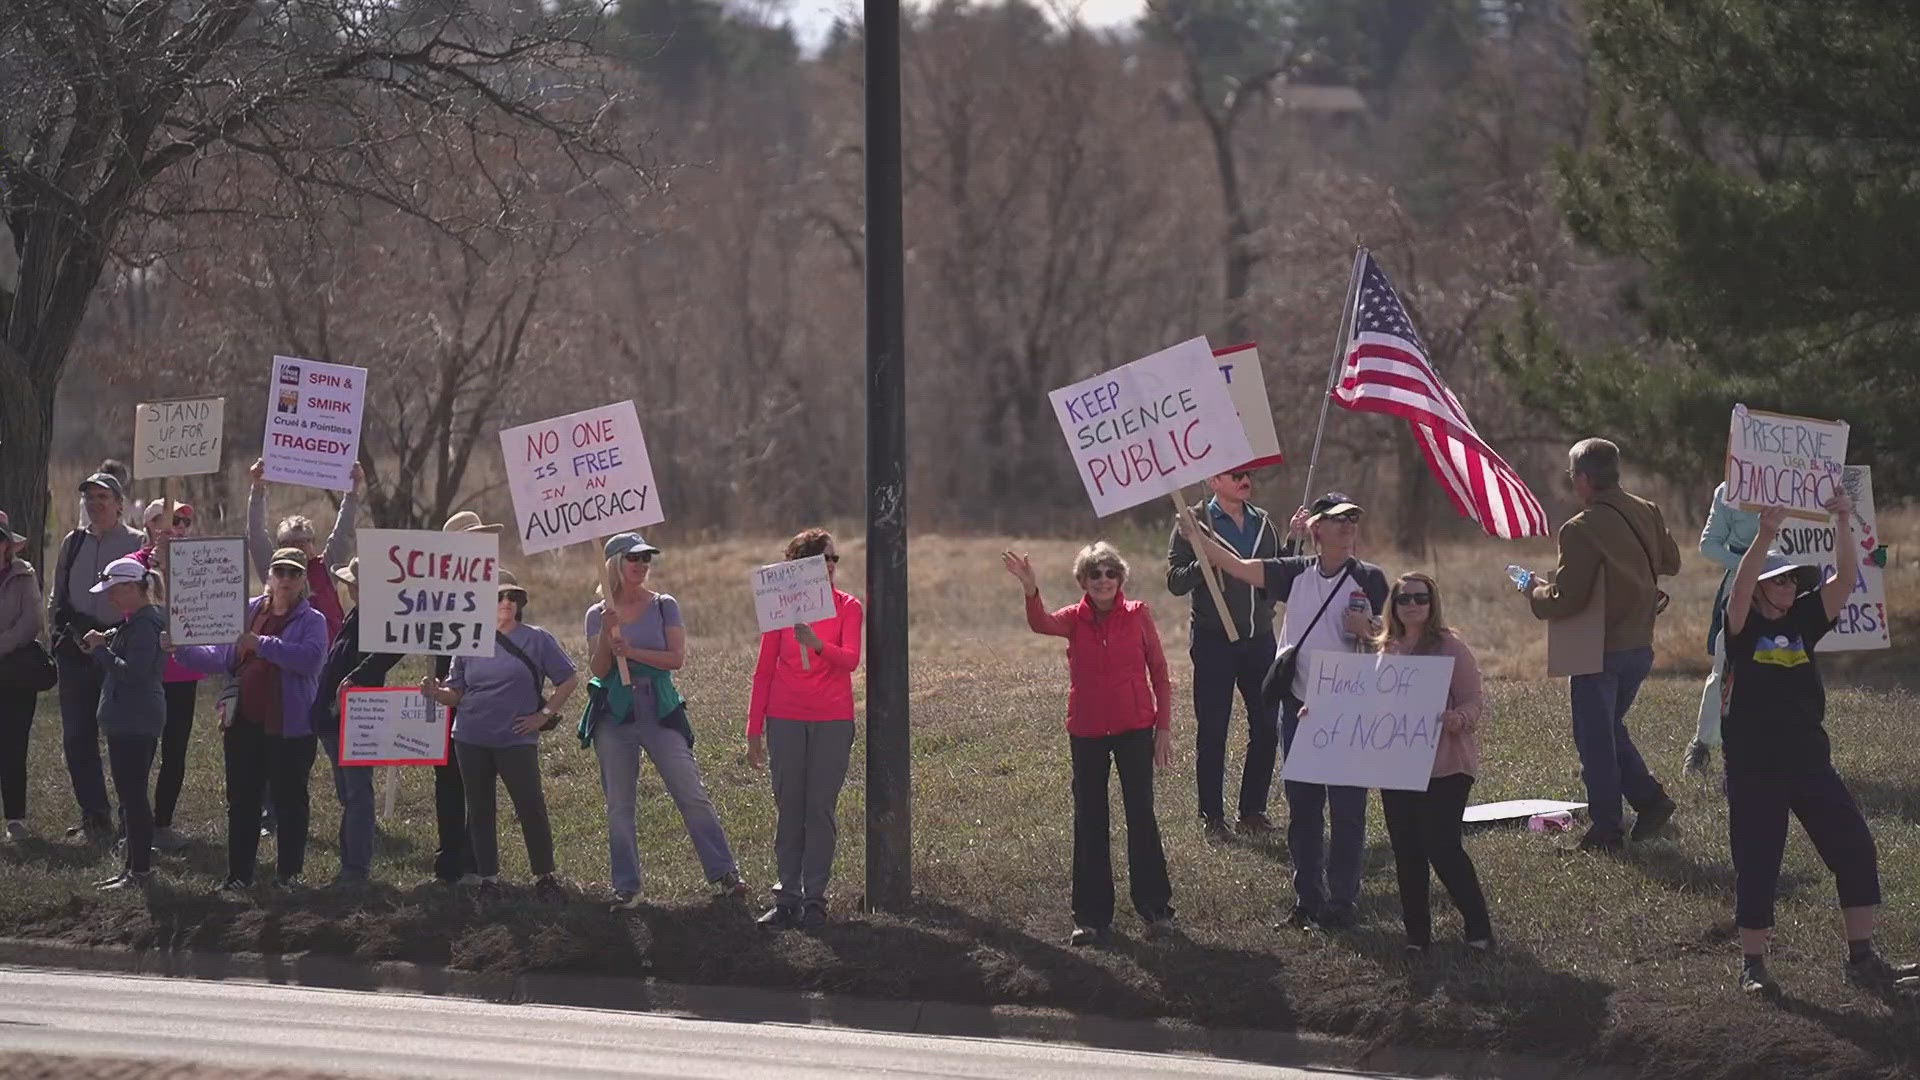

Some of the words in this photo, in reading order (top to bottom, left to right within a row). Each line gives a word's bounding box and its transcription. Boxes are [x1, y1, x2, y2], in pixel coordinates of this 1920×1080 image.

[309, 373, 340, 388] SPIN
[343, 378, 353, 390] &
[147, 402, 210, 422] STAND
[307, 397, 352, 413] SMIRK
[1065, 381, 1120, 424] KEEP
[160, 425, 176, 441] UP
[181, 423, 204, 438] FOR
[274, 416, 299, 427] Cruel
[301, 420, 308, 429] &
[310, 421, 352, 435] Pointless
[1077, 388, 1198, 450] SCIENCE
[145, 437, 218, 463] SCIENCE!
[272, 433, 351, 456] TRAGEDY
[527, 430, 559, 461] NO
[572, 419, 615, 448] ONE
[1741, 416, 1832, 459] PRESERVE
[534, 462, 558, 480] IS
[572, 447, 623, 477] FREE
[1088, 419, 1212, 496] PUBLIC
[542, 485, 566, 501] IN
[585, 475, 607, 490] AN
[525, 485, 647, 540] AUTOCRACY
[387, 545, 495, 584] SCIENCE
[394, 588, 476, 615] SAVES
[385, 621, 482, 651] LIVES!
[1317, 660, 1365, 696] Hands
[1376, 664, 1420, 697] Off
[404, 695, 409, 708] I
[1313, 713, 1345, 749] of
[1350, 712, 1441, 750] NOAA!
